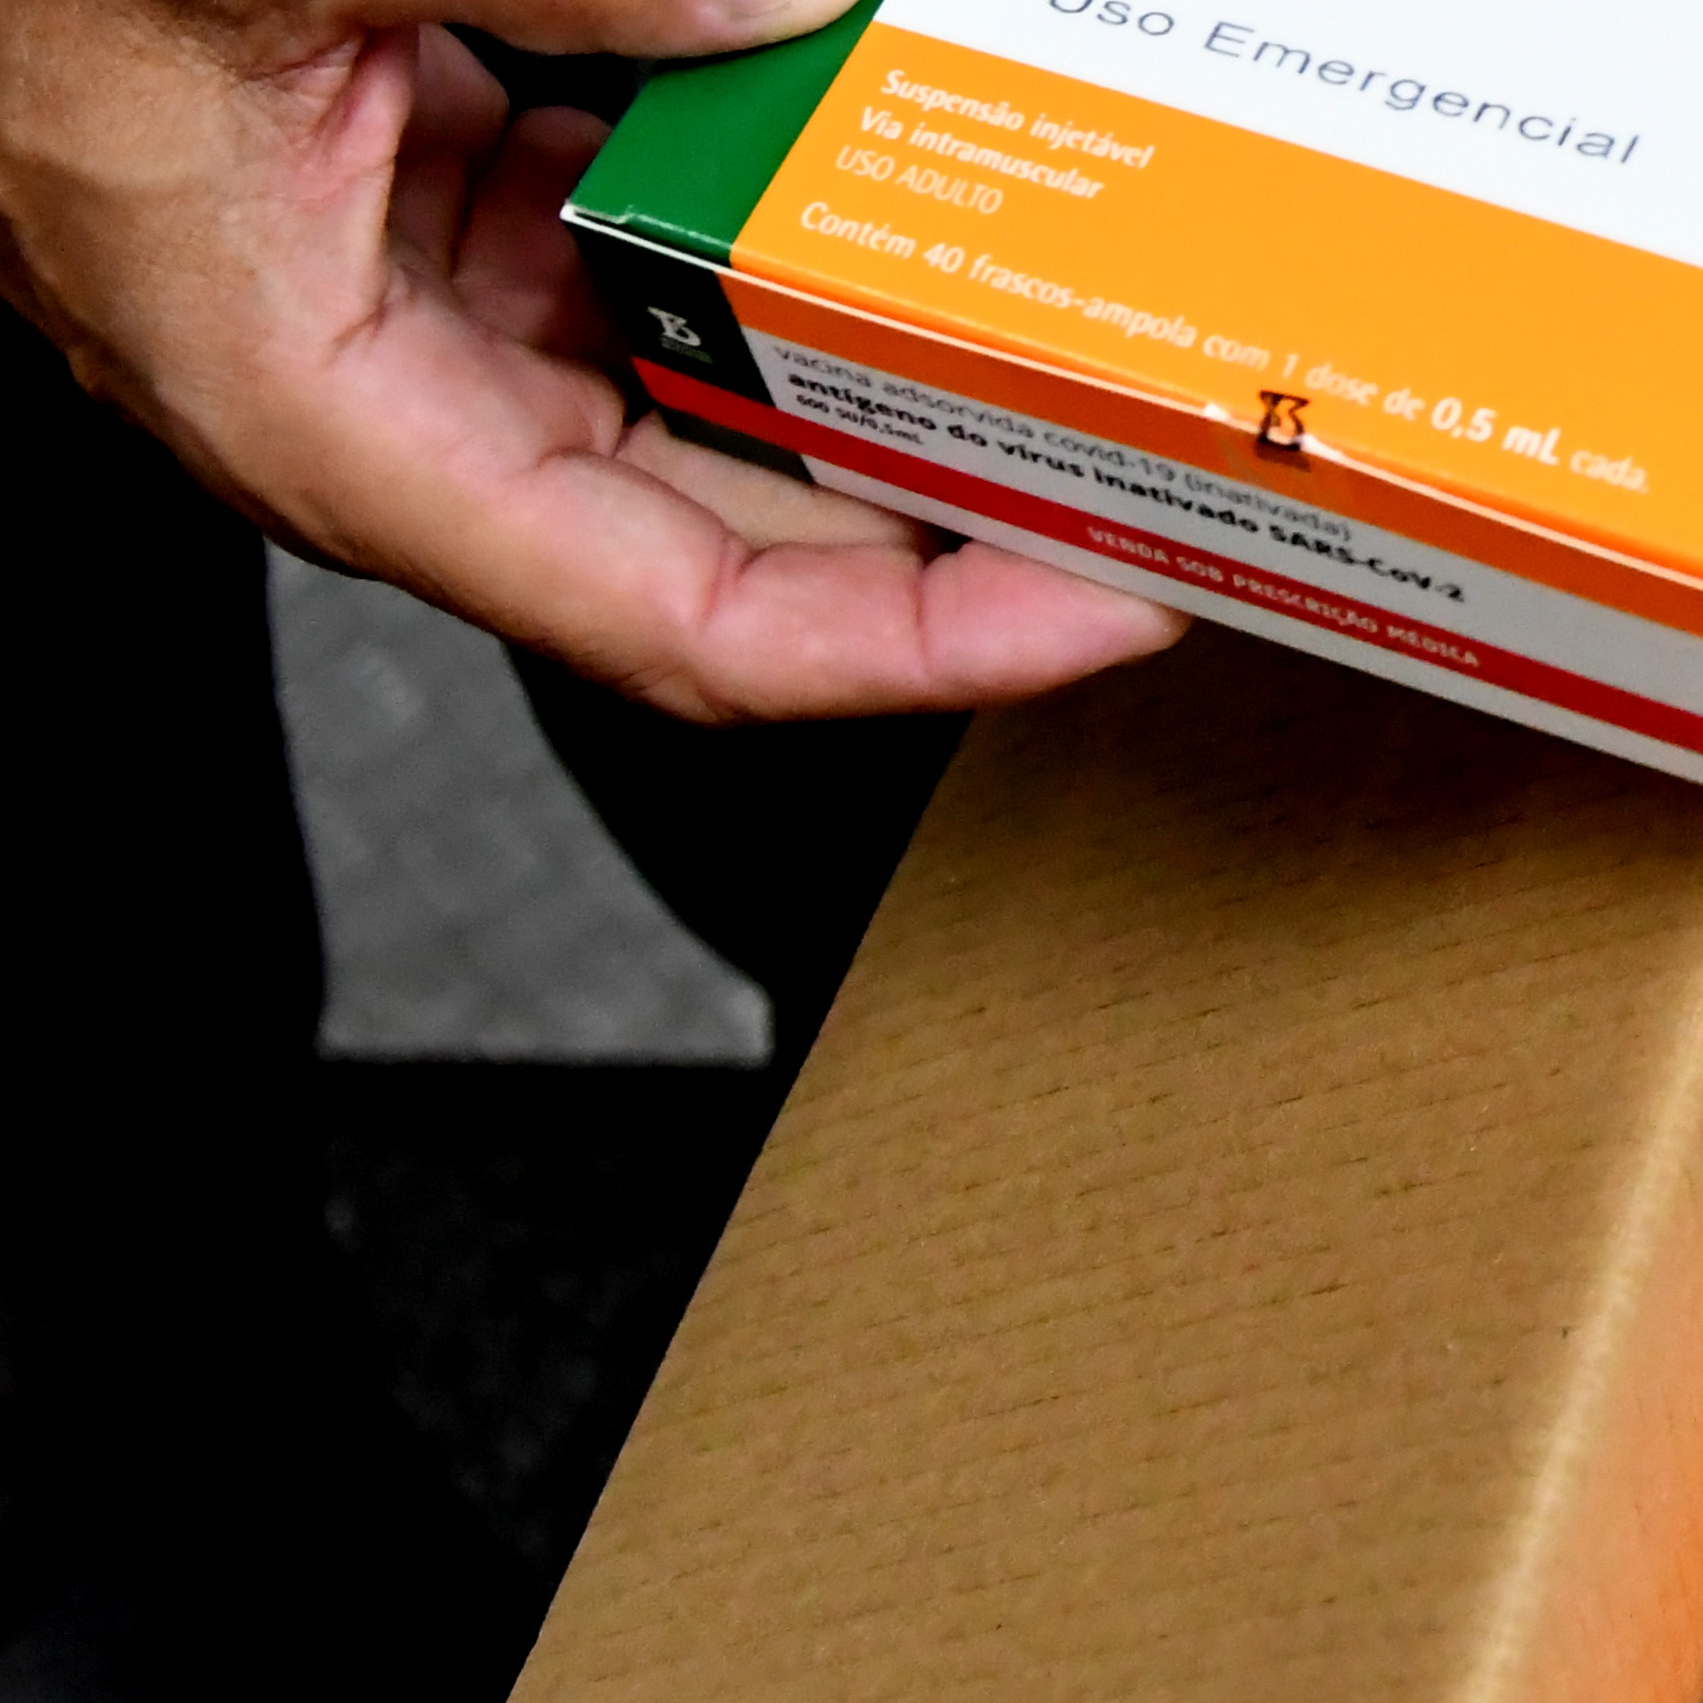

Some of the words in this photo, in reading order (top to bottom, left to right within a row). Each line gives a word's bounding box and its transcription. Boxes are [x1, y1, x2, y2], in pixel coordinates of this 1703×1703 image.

[879, 68, 1025, 131] Suspensão
[1028, 112, 1156, 170] injetável
[1202, 20, 1640, 165] Emergencial
[835, 144, 897, 182] USO
[894, 164, 1005, 215] ADULTO
[860, 105, 903, 140] Via
[909, 122, 1105, 200] intramuscular
[799, 200, 918, 260] Contém
[922, 242, 966, 274] 40
[967, 253, 1198, 349] frascos-ampola
[1201, 334, 1272, 372] com
[1303, 362, 1380, 407] dose
[1381, 387, 1427, 422] de
[1430, 396, 1498, 444] 0,5
[1501, 425, 1562, 466] mL
[1569, 449, 1655, 498] cada.
